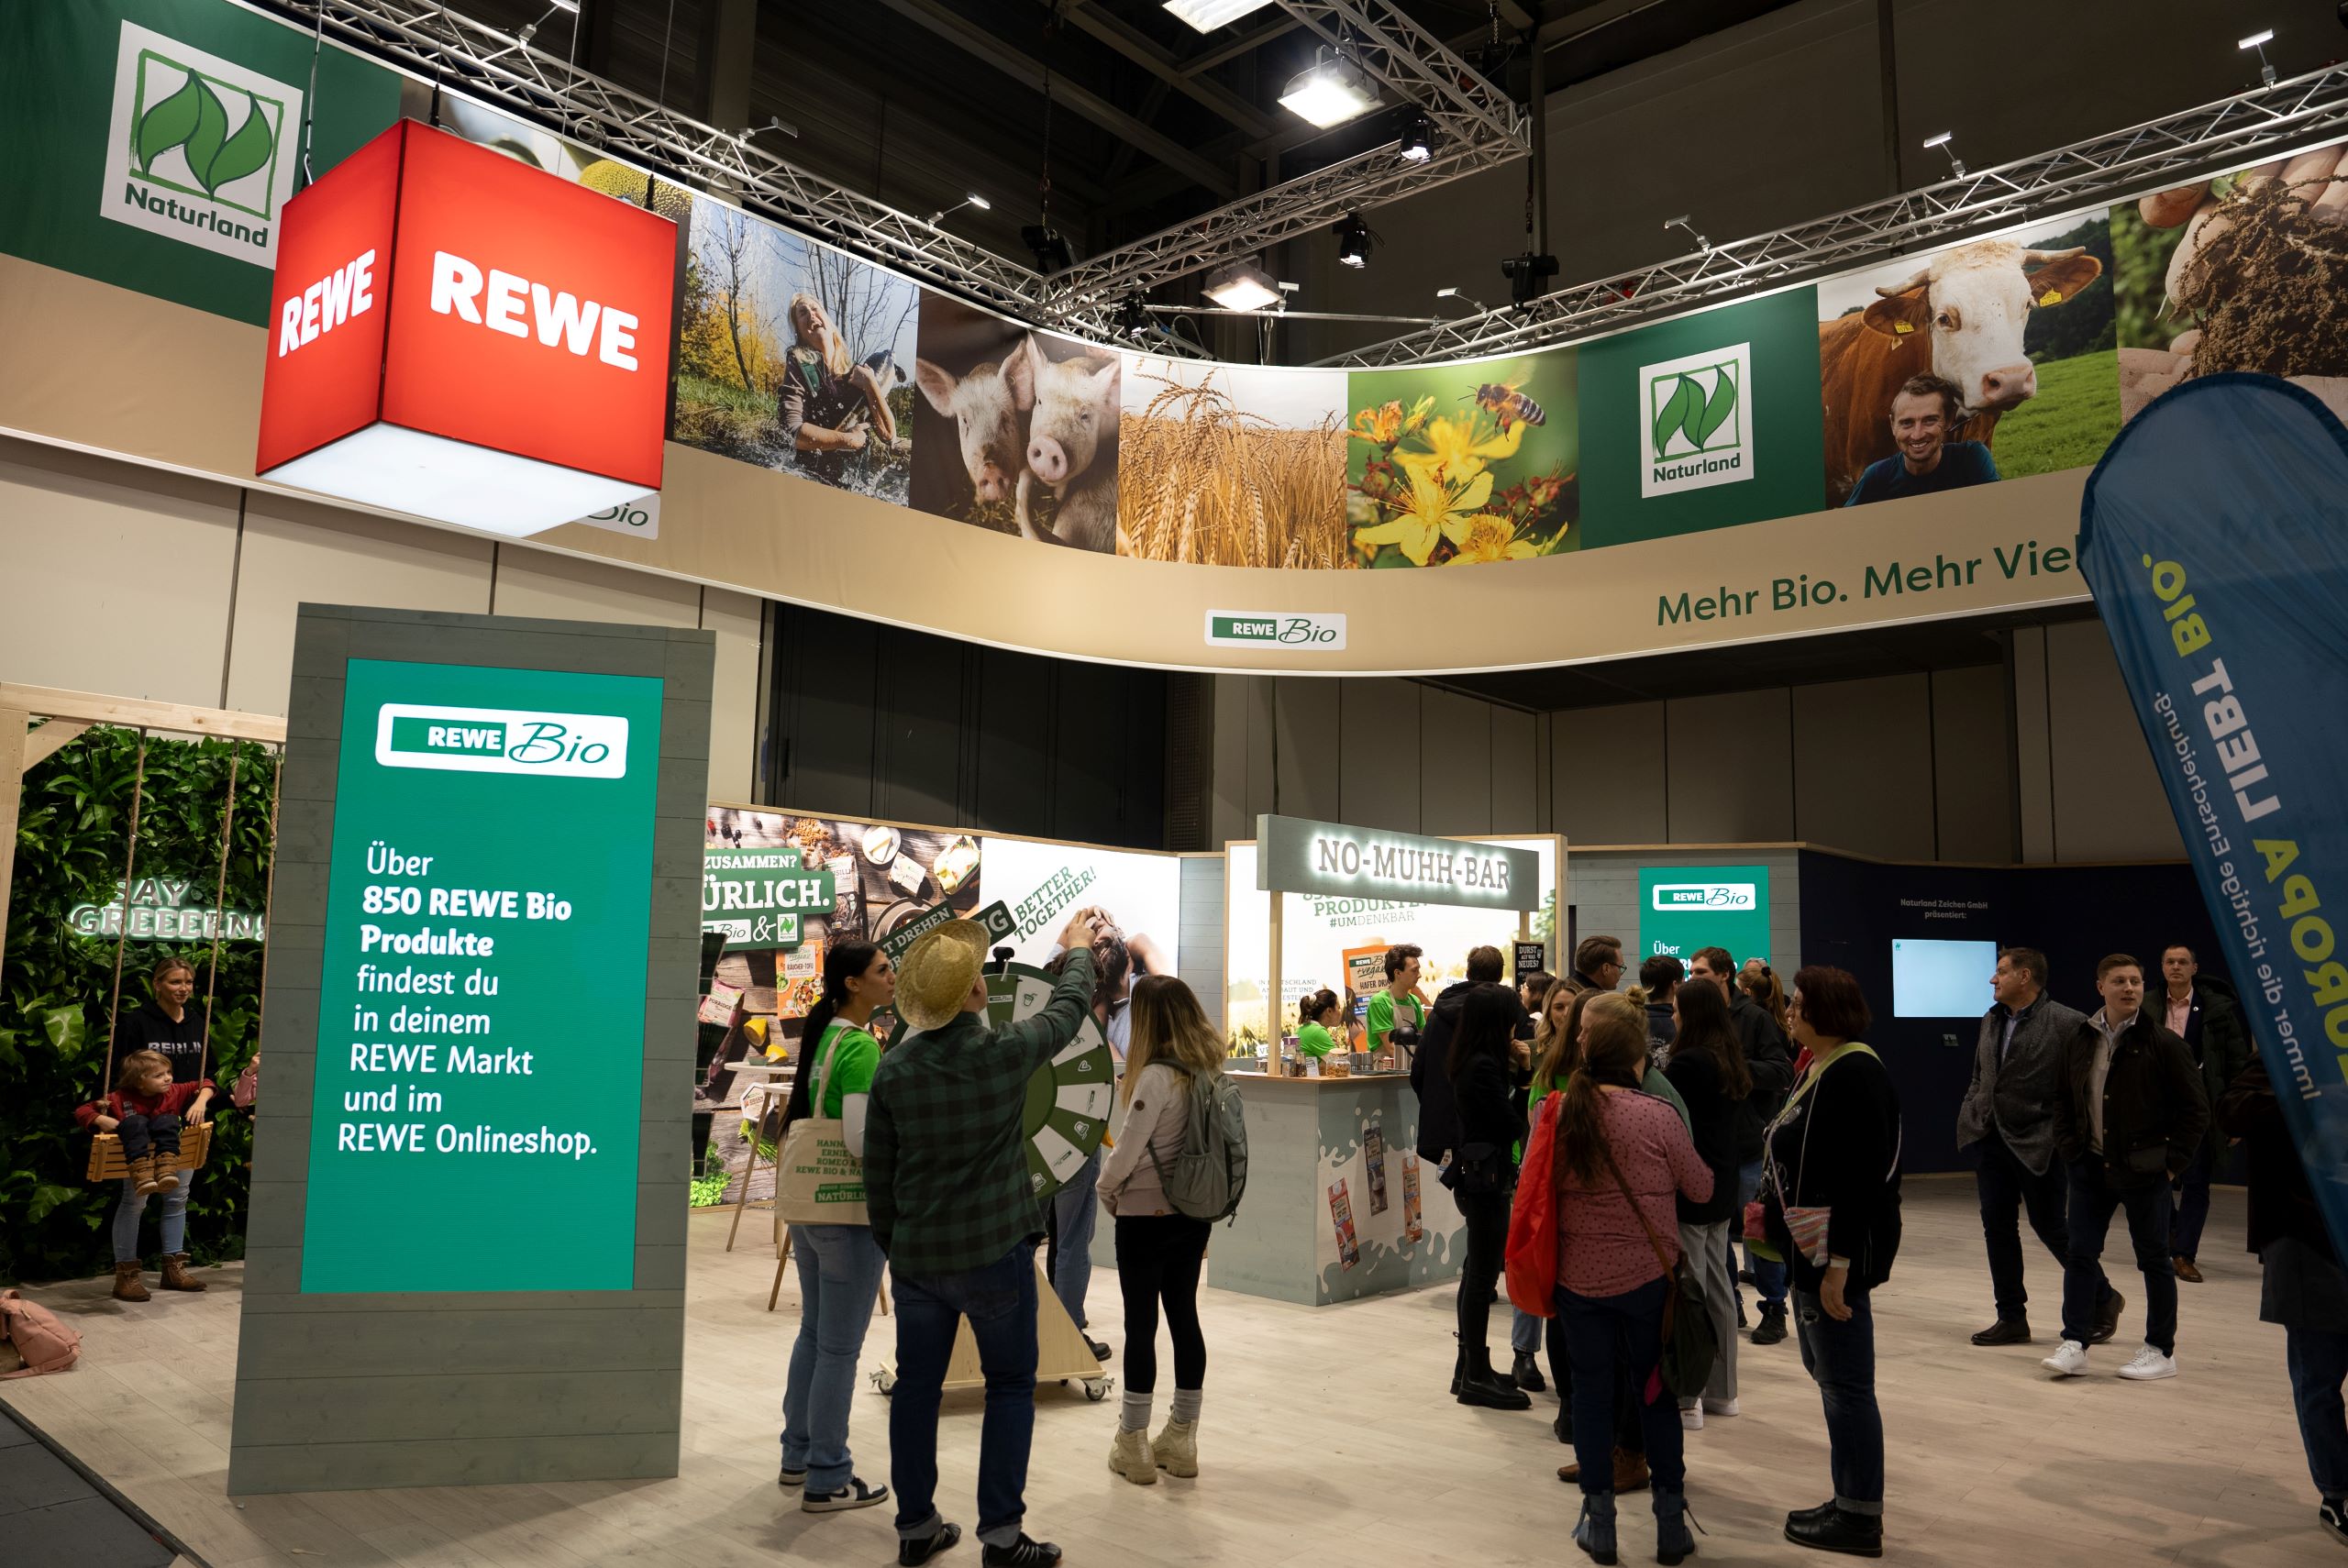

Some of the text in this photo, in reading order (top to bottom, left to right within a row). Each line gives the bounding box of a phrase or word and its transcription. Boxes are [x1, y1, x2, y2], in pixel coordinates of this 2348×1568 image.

[125, 182, 268, 248] Naturland
[279, 248, 375, 358] REWE
[430, 250, 638, 371] REWE
[1653, 453, 1741, 483] Naturland
[587, 502, 648, 526] io
[1657, 586, 1759, 626] Mehr
[1772, 574, 1848, 611] Bio.
[1864, 554, 1982, 599] Mehr
[1233, 618, 1336, 644] REWE Bio
[428, 722, 609, 764] REWE Bio
[367, 840, 434, 877] Über
[704, 855, 797, 869] ZUSAMMEN?
[1317, 838, 1511, 890] NO-MUHH-BAR
[111, 878, 191, 907] SAY
[362, 885, 572, 921] 850 REWE Bio
[1013, 866, 1073, 922] BETTER
[1013, 866, 1097, 944] TOGETHER!
[1673, 888, 1748, 906] REWE Bio
[1900, 899, 1936, 908] Naturland
[1938, 900, 1966, 909] Zeichen
[719, 923, 746, 938] Bio
[895, 907, 950, 948] DREHEN
[1330, 911, 1415, 928] #UMDENKBAR
[360, 924, 494, 957] Produkte
[1654, 941, 1680, 955] Über
[357, 964, 499, 996] findest du
[1518, 960, 1539, 968] NEUES?
[1360, 981, 1377, 989] HAFER
[354, 1004, 491, 1034] in deinem
[349, 1043, 534, 1075] REWE Markt
[344, 1084, 442, 1112] und im
[338, 1122, 597, 1160] REWE Onlineshop.
